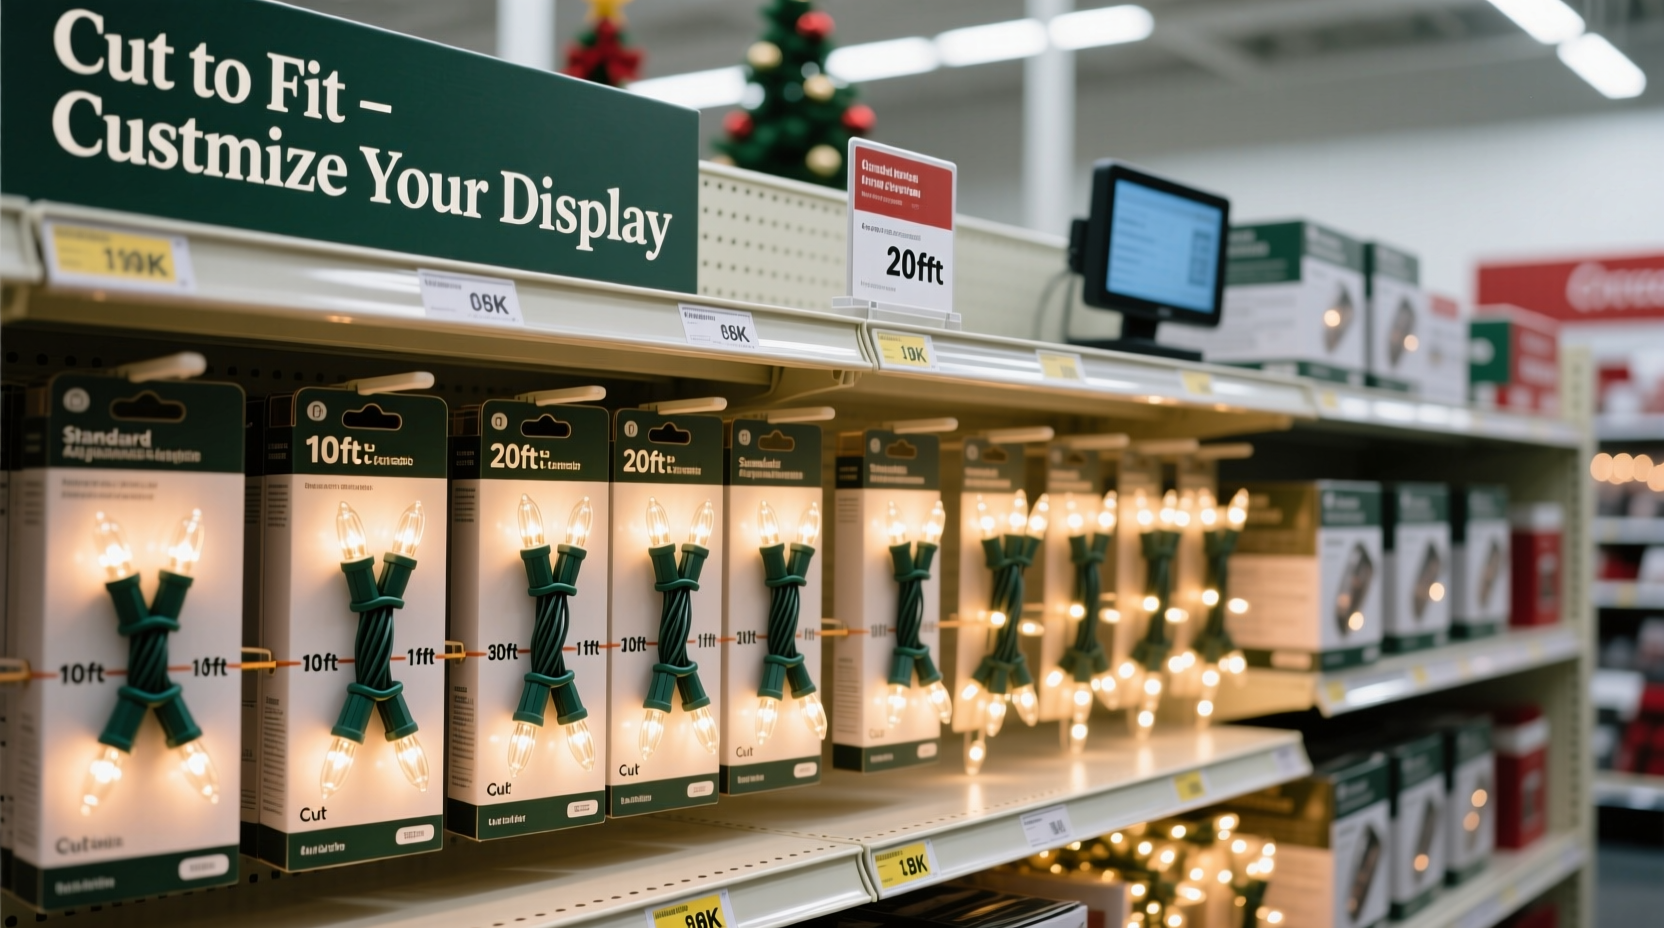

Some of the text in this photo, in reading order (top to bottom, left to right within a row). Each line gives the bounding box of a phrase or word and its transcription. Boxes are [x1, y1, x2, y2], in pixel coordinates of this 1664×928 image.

[53, 8, 174, 91] Cut
[190, 42, 251, 104] to
[267, 52, 346, 123] Fit
[52, 90, 672, 260] Custmize Your Display
[886, 246, 944, 286] 20fft
[306, 435, 362, 465] 10ft
[490, 442, 539, 470] 20ft
[623, 449, 666, 474] 20ft
[303, 653, 339, 672] 10ft
[488, 643, 518, 661] 30ft
[60, 663, 106, 684] 10ft
[619, 763, 640, 777] Cut
[300, 806, 328, 823] Cut
